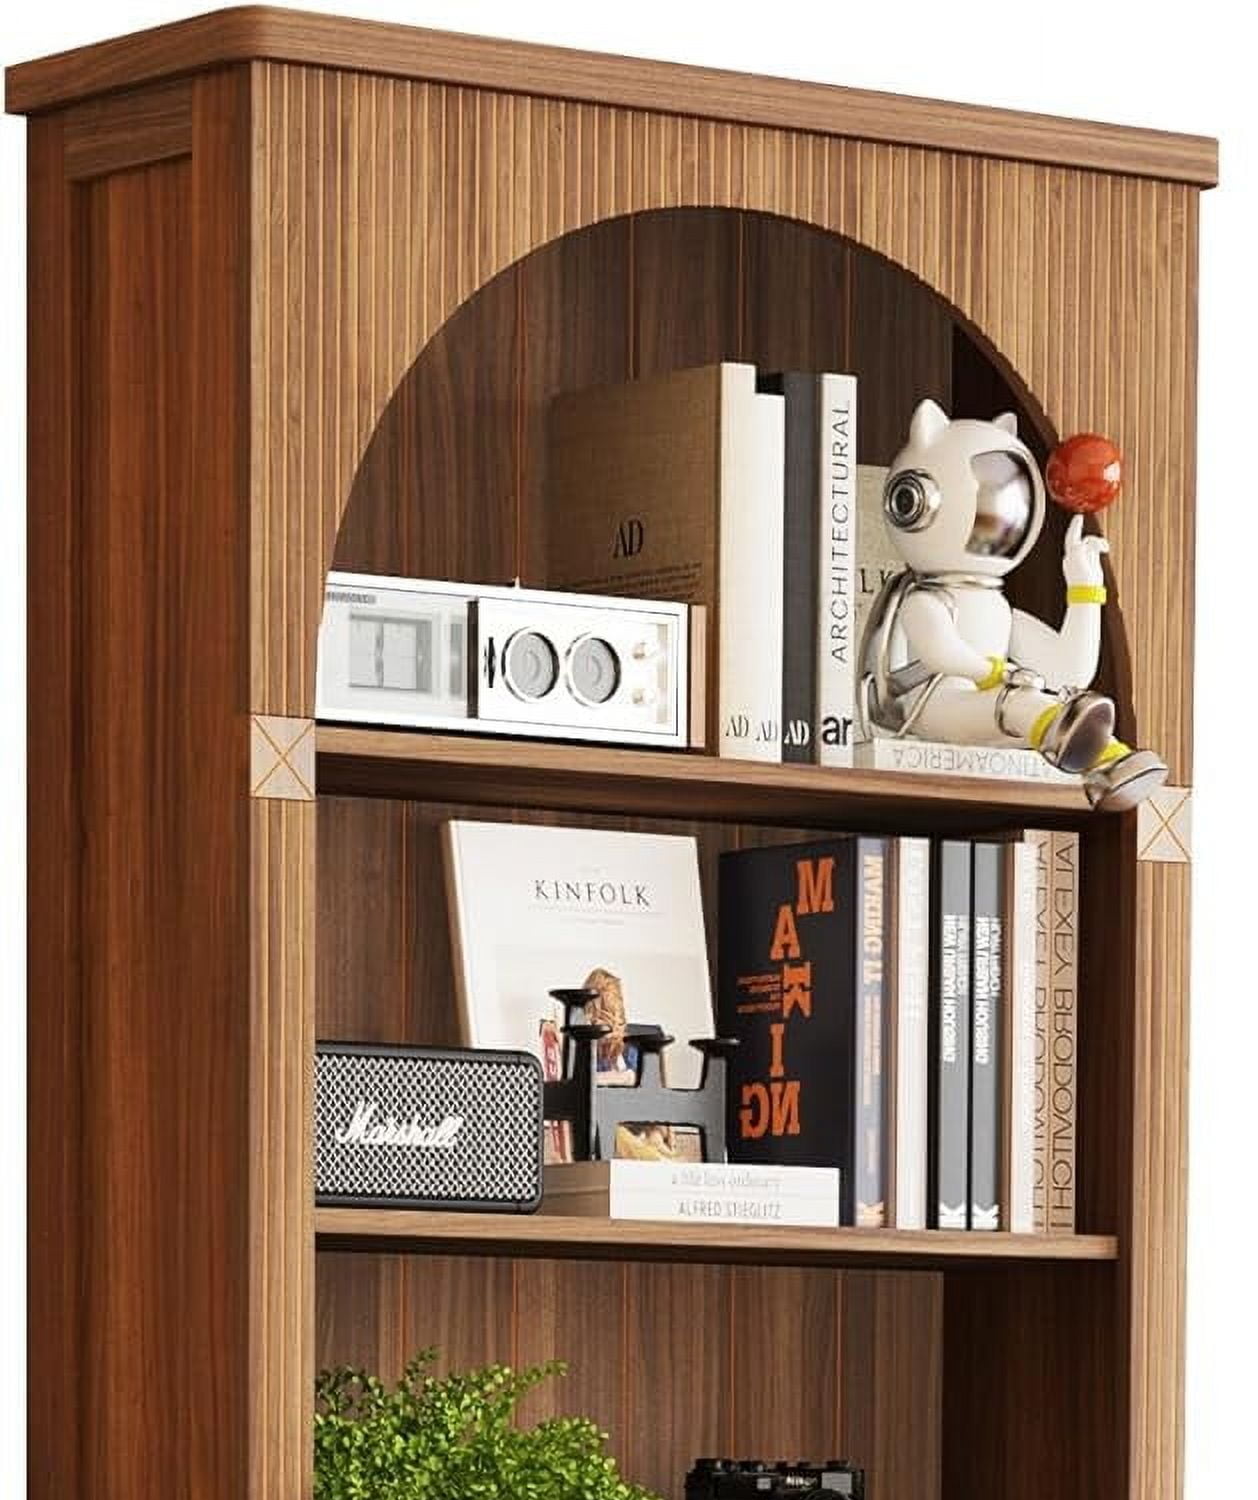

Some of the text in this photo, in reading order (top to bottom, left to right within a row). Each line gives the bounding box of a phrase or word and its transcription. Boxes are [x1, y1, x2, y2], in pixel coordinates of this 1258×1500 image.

[611, 518, 645, 560] AD
[830, 399, 851, 665] ARCHITECTURAL
[725, 714, 750, 741] AD
[784, 719, 811, 747] AD
[822, 716, 854, 748] ar
[534, 879, 651, 907] KINFOLK
[337, 1101, 466, 1150] Marshall
[678, 1200, 722, 1217] ALFRED
